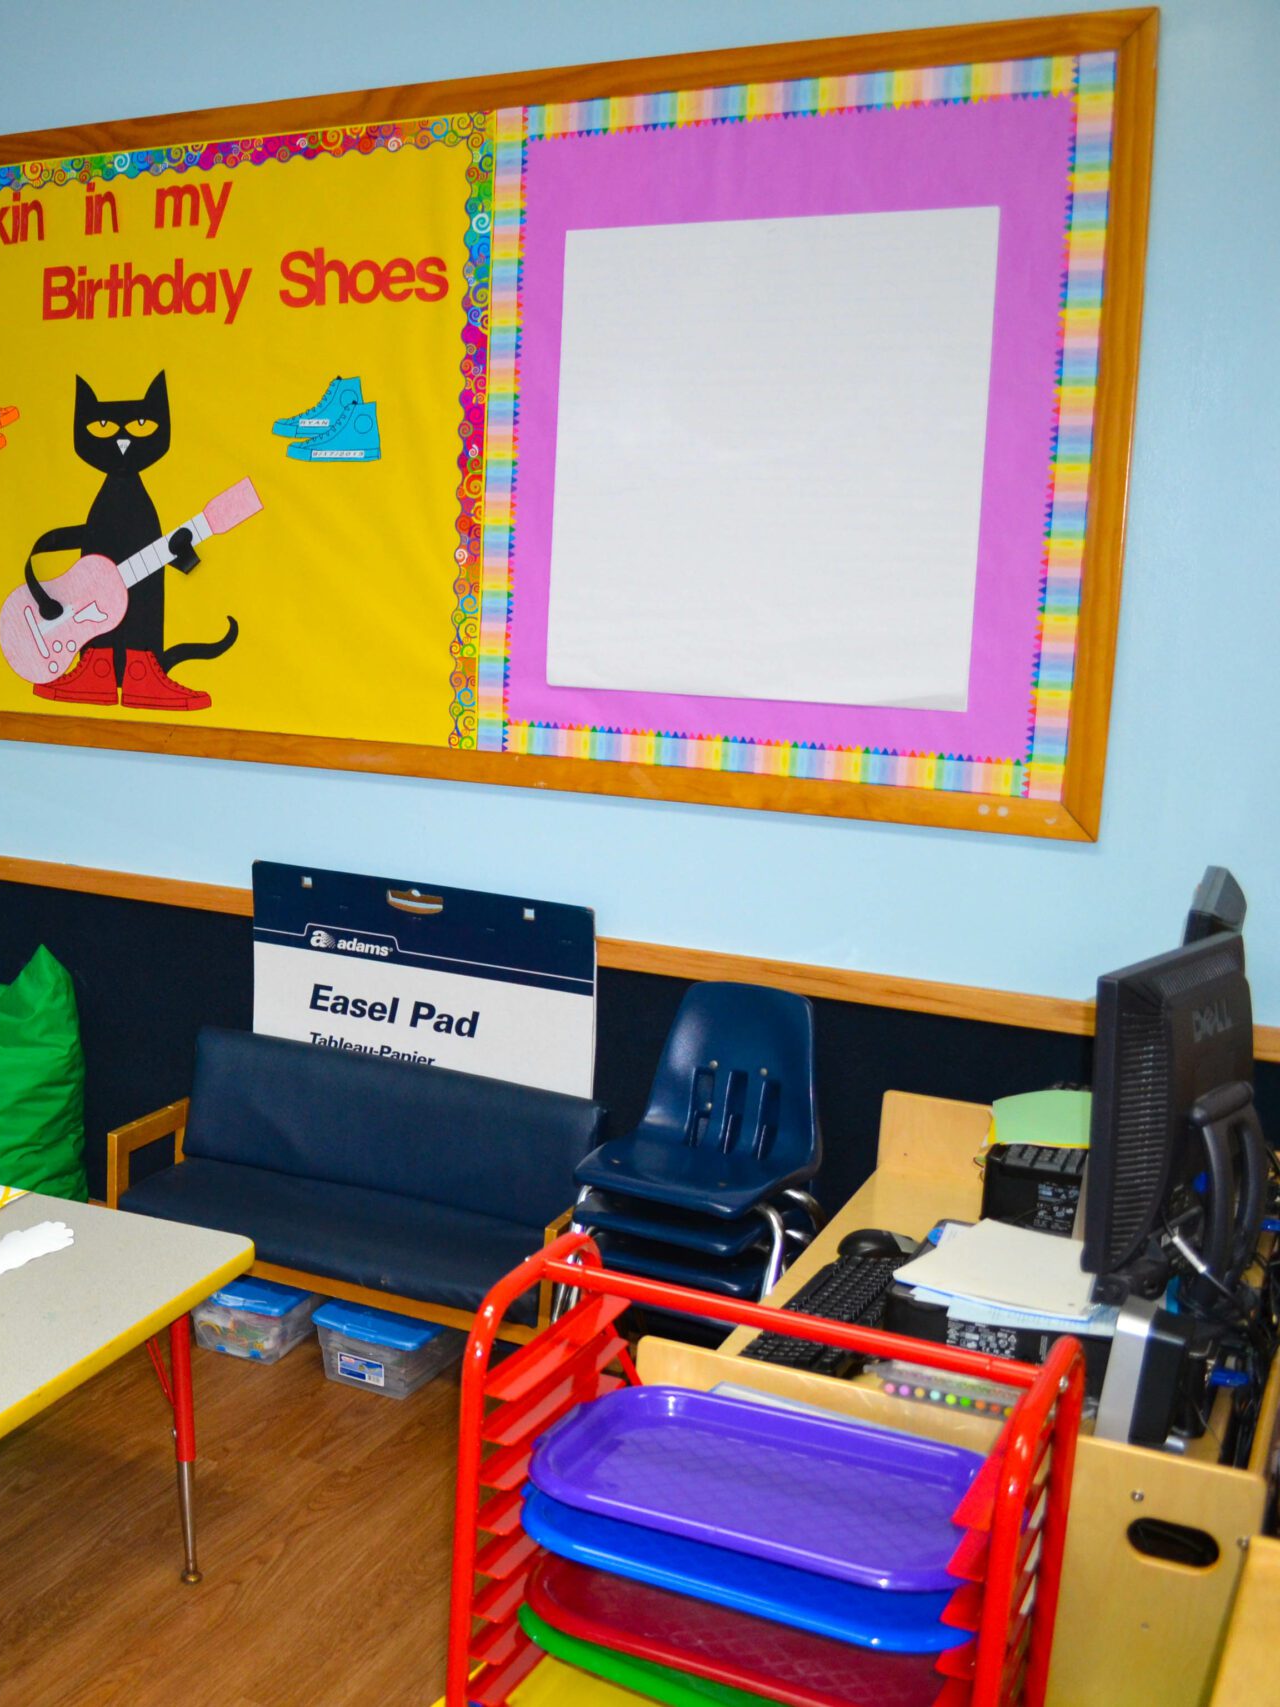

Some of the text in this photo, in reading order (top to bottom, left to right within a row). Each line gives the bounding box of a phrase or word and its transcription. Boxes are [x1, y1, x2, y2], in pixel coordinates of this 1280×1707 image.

[84, 182, 119, 236] in
[153, 181, 234, 239] my
[42, 247, 450, 325] Birthday Shoes
[337, 937, 389, 957] adams
[309, 983, 481, 1039] Easel Pad
[1192, 999, 1233, 1042] DELL
